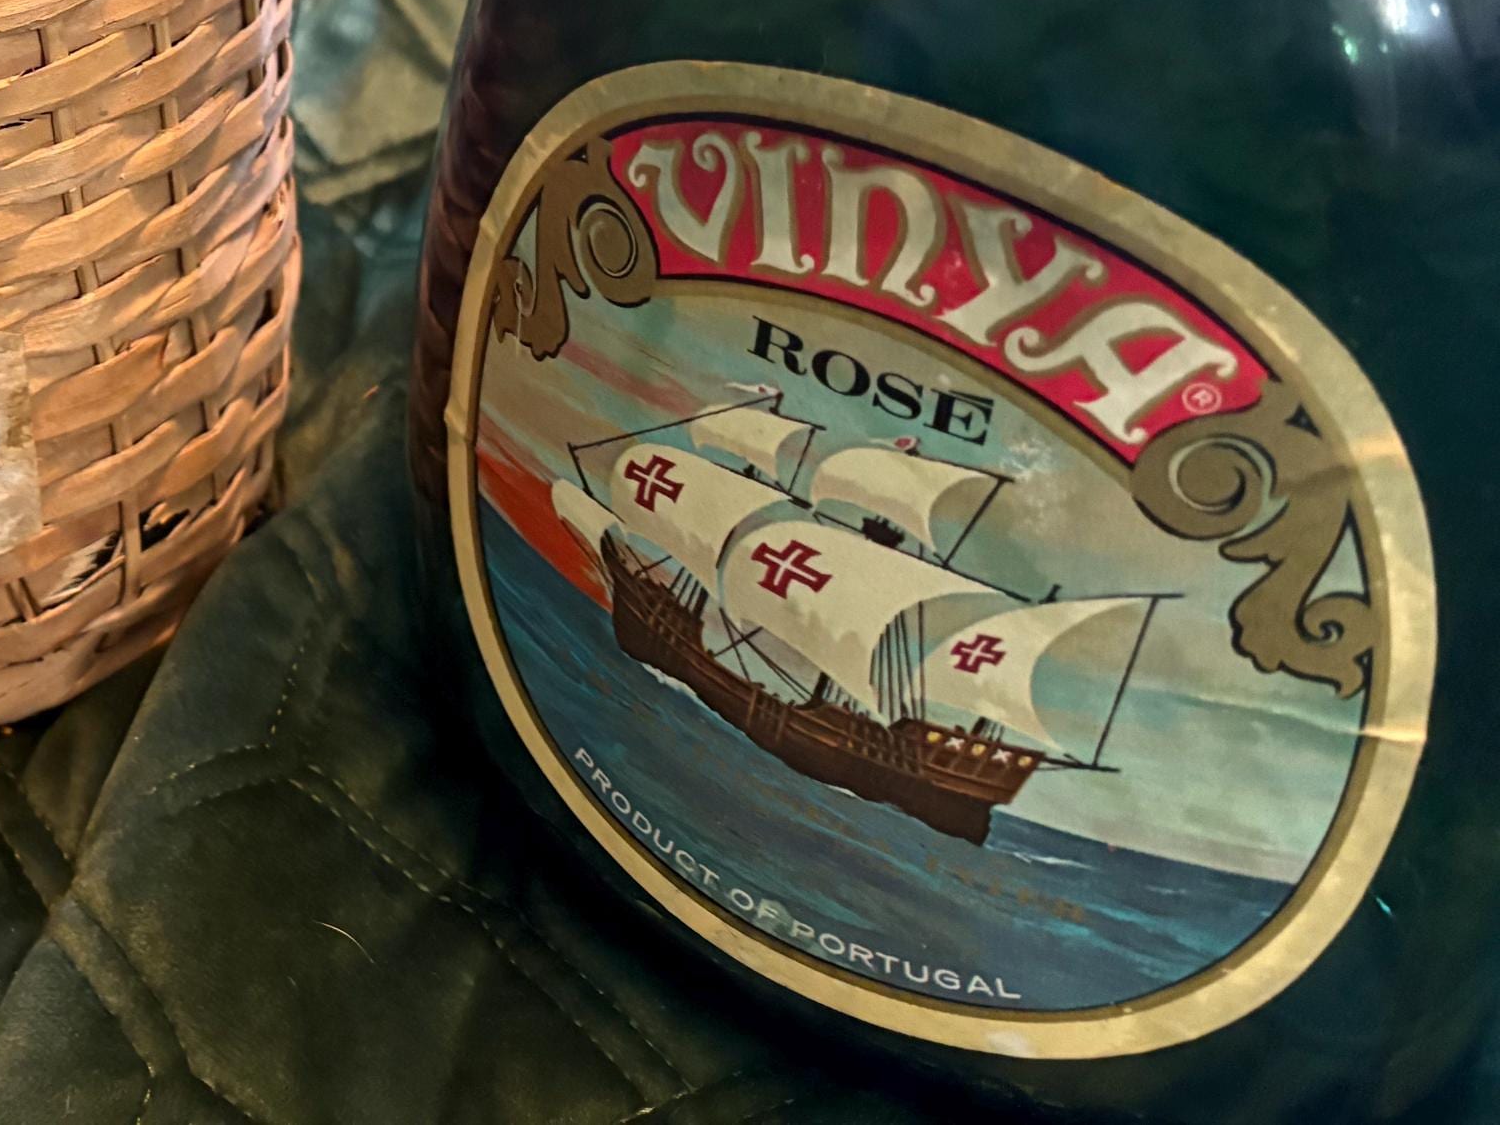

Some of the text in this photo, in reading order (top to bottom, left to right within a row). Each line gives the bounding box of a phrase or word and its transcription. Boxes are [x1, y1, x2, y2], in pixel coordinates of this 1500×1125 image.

[627, 131, 1240, 445] VINYA
[573, 747, 1022, 1000] PRODUCT OF PORTUGAL
